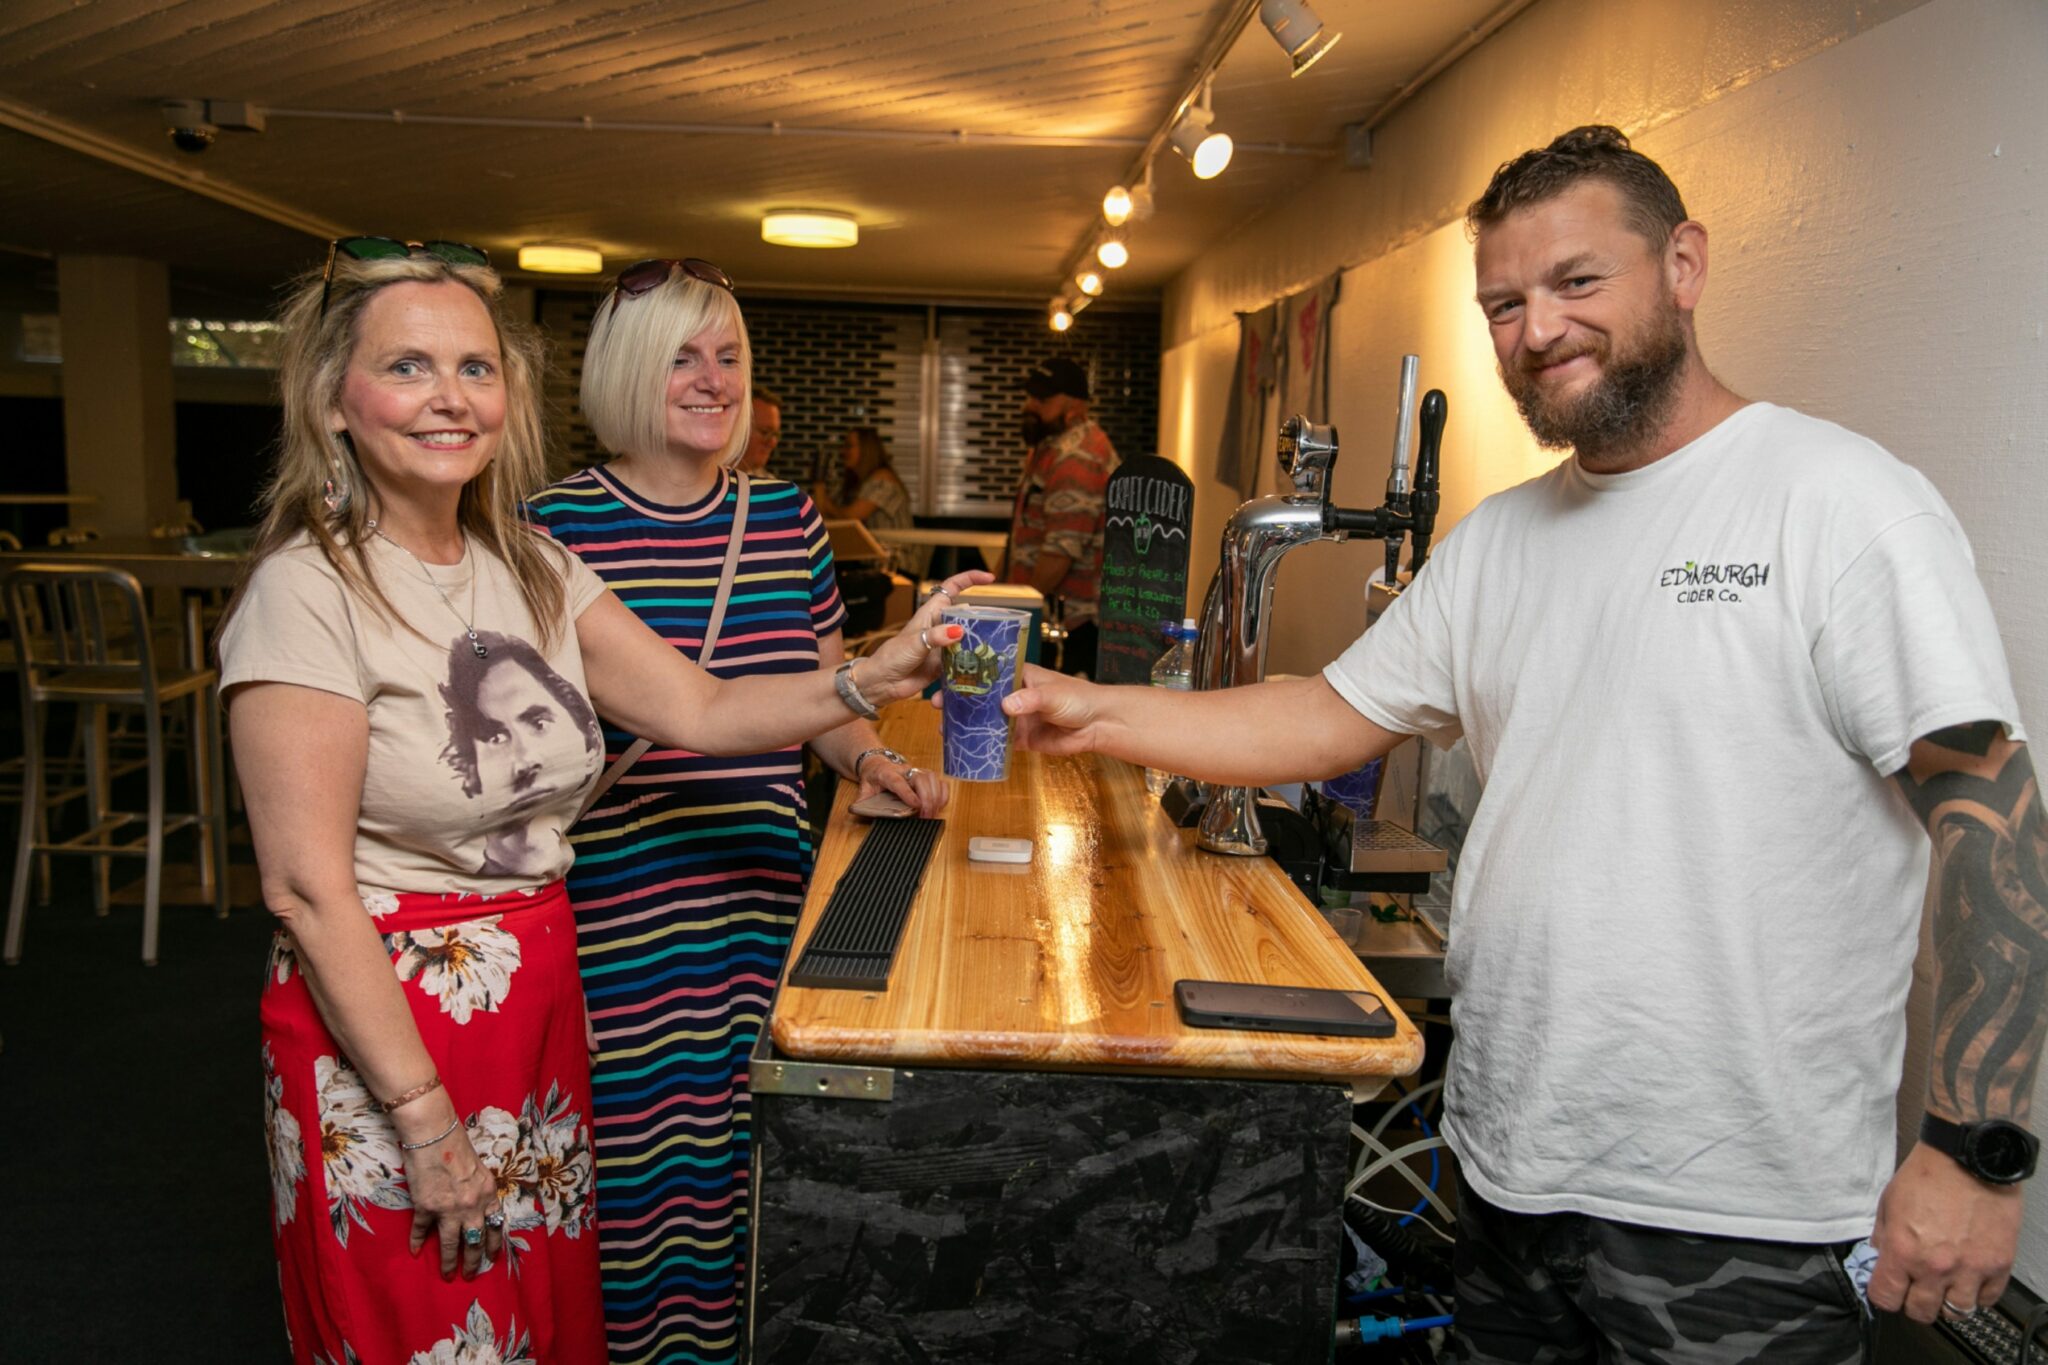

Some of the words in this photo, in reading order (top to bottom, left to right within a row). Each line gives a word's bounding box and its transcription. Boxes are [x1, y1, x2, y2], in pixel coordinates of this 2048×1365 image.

[1108, 475, 1144, 513] CRAFT
[1144, 477, 1188, 526] CIDER
[1660, 561, 1770, 588] EDINBURGH
[1676, 588, 1715, 604] CIDER
